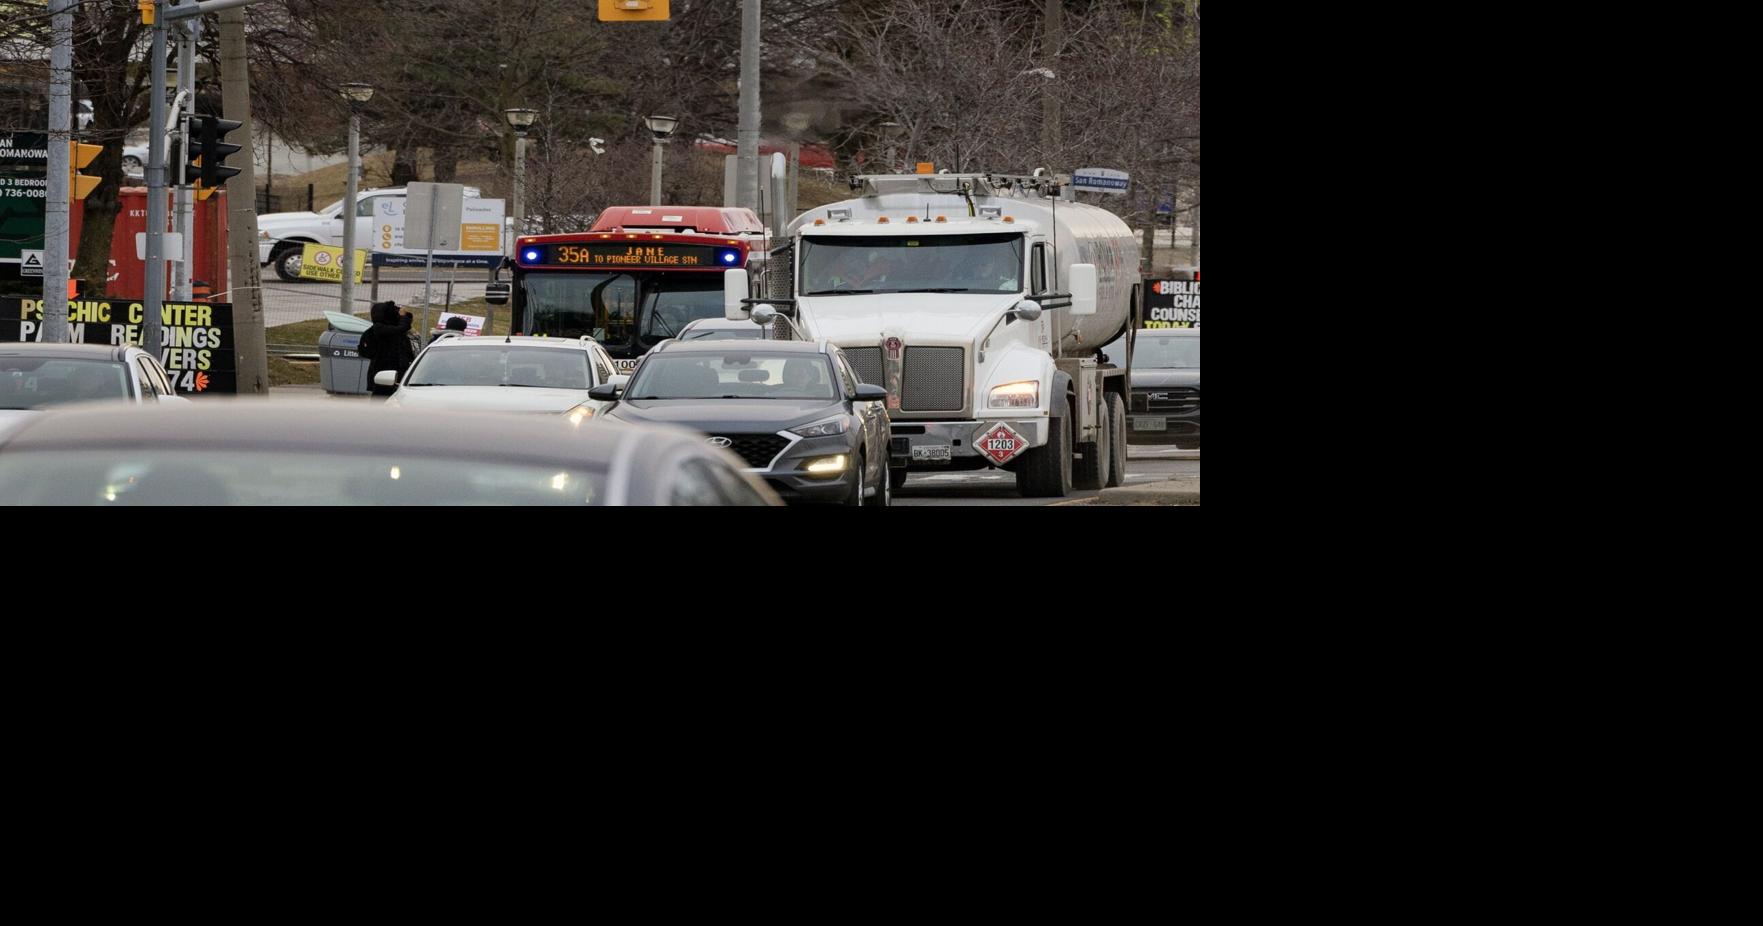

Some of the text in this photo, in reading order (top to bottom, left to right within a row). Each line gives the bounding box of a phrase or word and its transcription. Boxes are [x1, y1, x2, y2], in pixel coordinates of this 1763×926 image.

[558, 246, 590, 263] 35A
[594, 255, 697, 264] TO PIONEER VILLAGE STN
[21, 300, 212, 327] PSCHIC CNTER
[989, 439, 1014, 450] 1203
